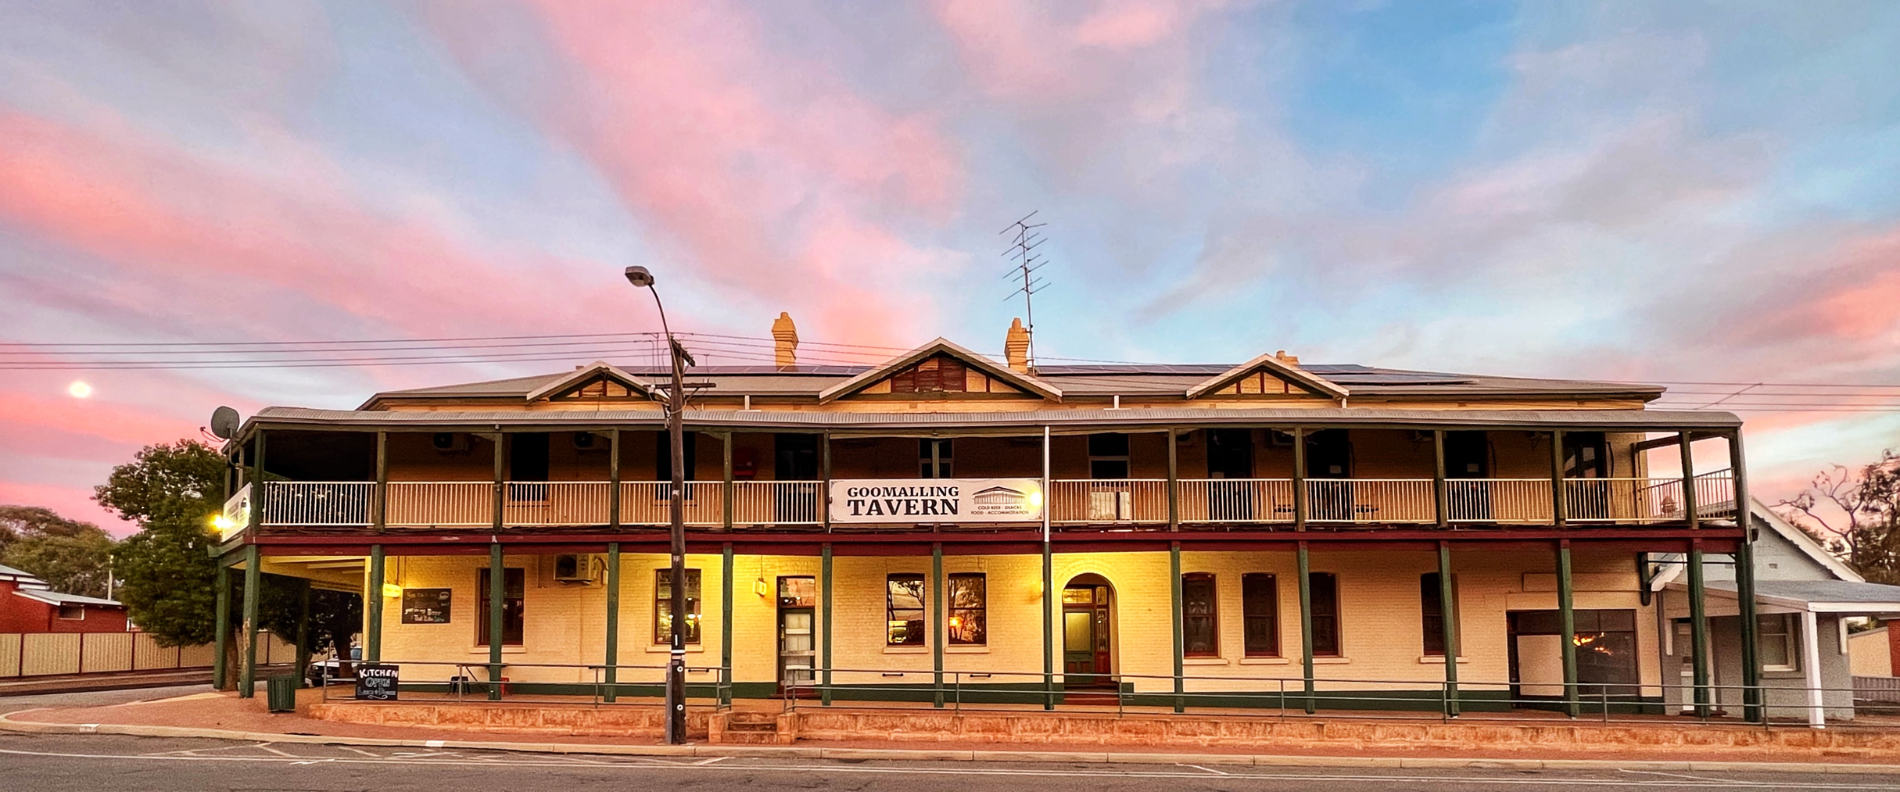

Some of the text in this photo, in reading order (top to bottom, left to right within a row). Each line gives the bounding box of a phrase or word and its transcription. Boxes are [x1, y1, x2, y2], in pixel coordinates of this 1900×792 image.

[847, 486, 960, 498] GOOMALLING
[847, 499, 960, 516] TAVERN
[359, 668, 399, 679] KITCHEN
